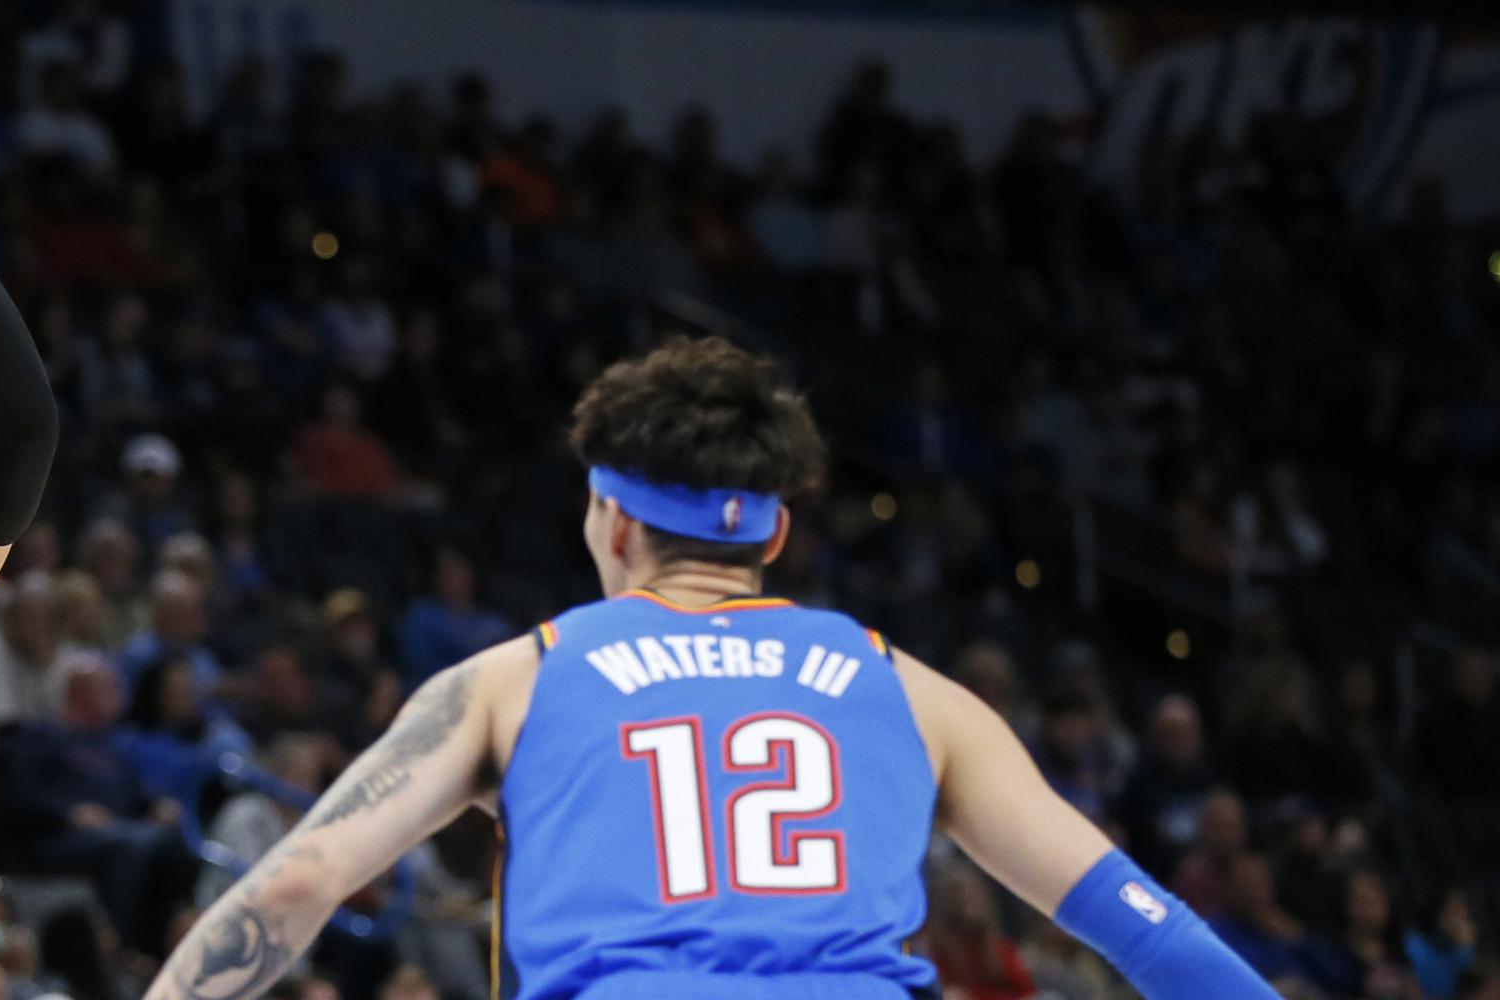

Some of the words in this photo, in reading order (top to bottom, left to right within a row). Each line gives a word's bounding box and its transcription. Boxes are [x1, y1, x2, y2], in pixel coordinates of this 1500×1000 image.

[585, 634, 785, 695] WATERS
[796, 644, 861, 697] III
[618, 711, 848, 905] 12
